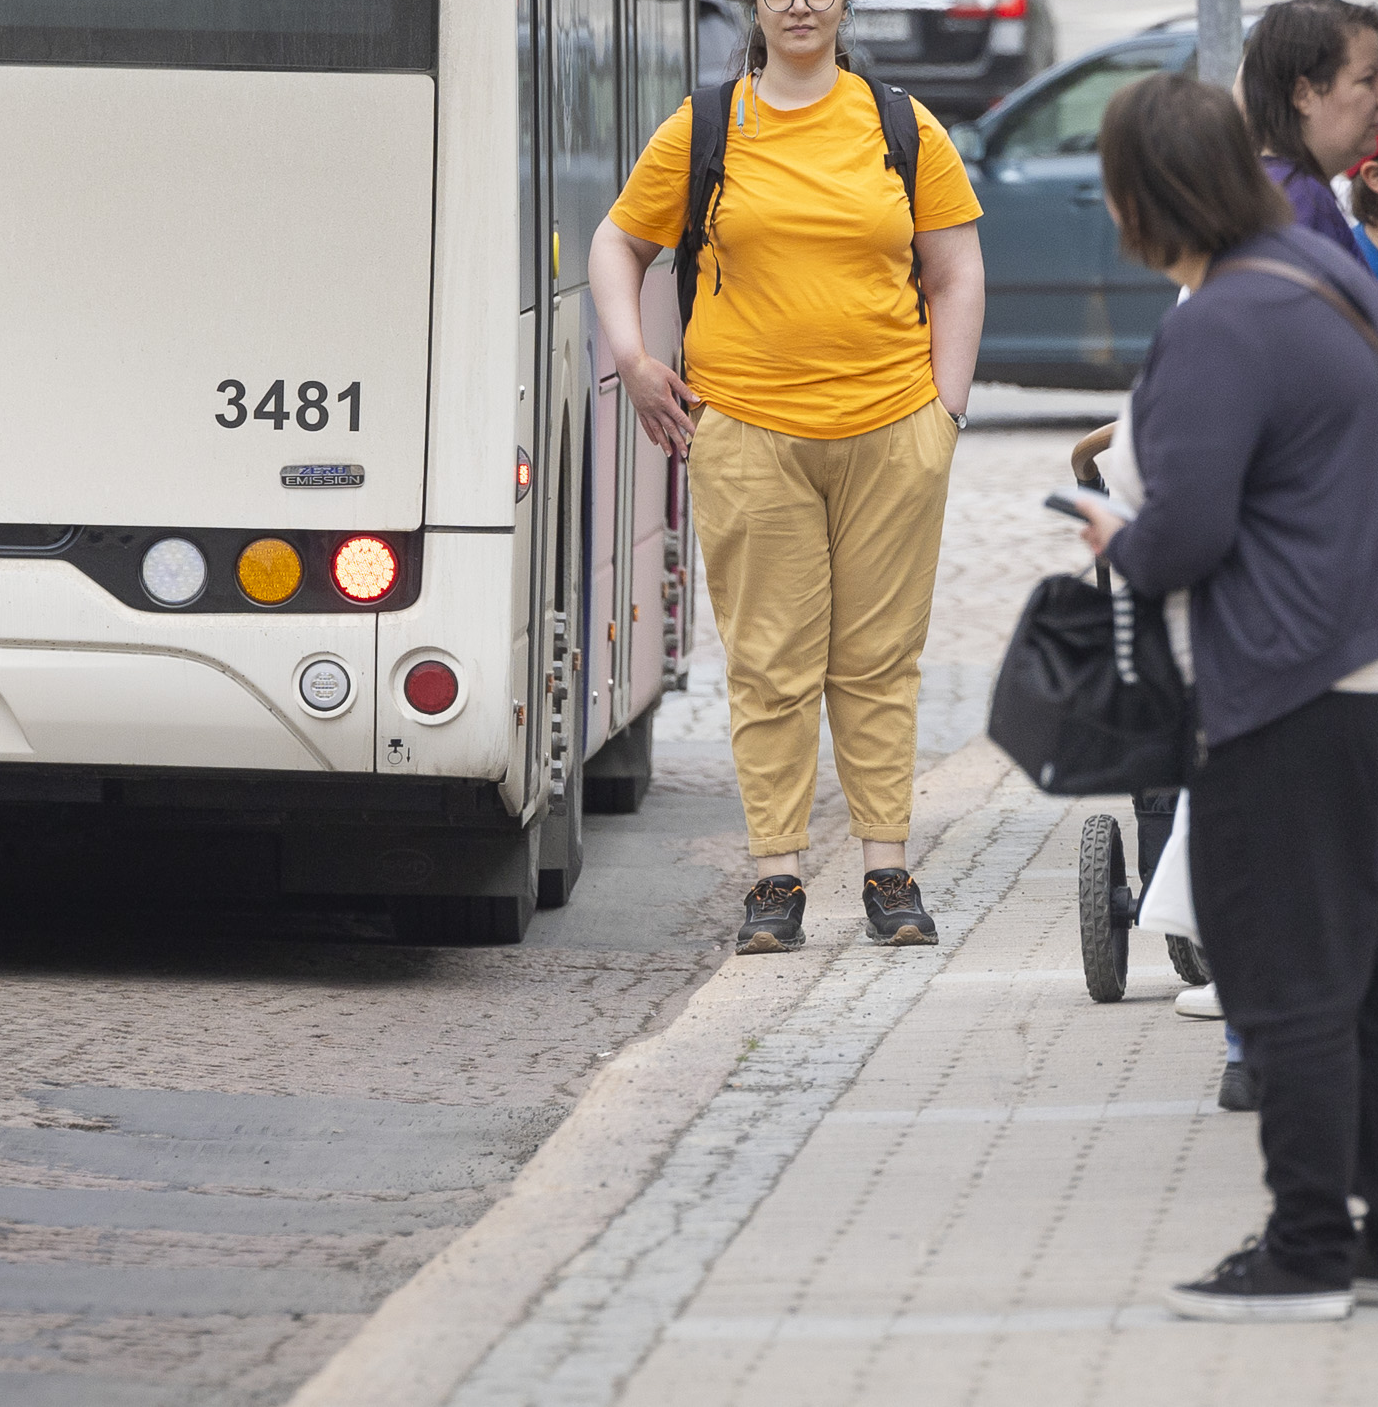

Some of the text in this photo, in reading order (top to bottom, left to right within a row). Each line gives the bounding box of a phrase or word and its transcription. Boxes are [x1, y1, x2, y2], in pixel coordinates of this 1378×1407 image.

[214, 379, 362, 432] 3481
[299, 466, 346, 475] ZERO
[286, 476, 360, 485] EMISSION
